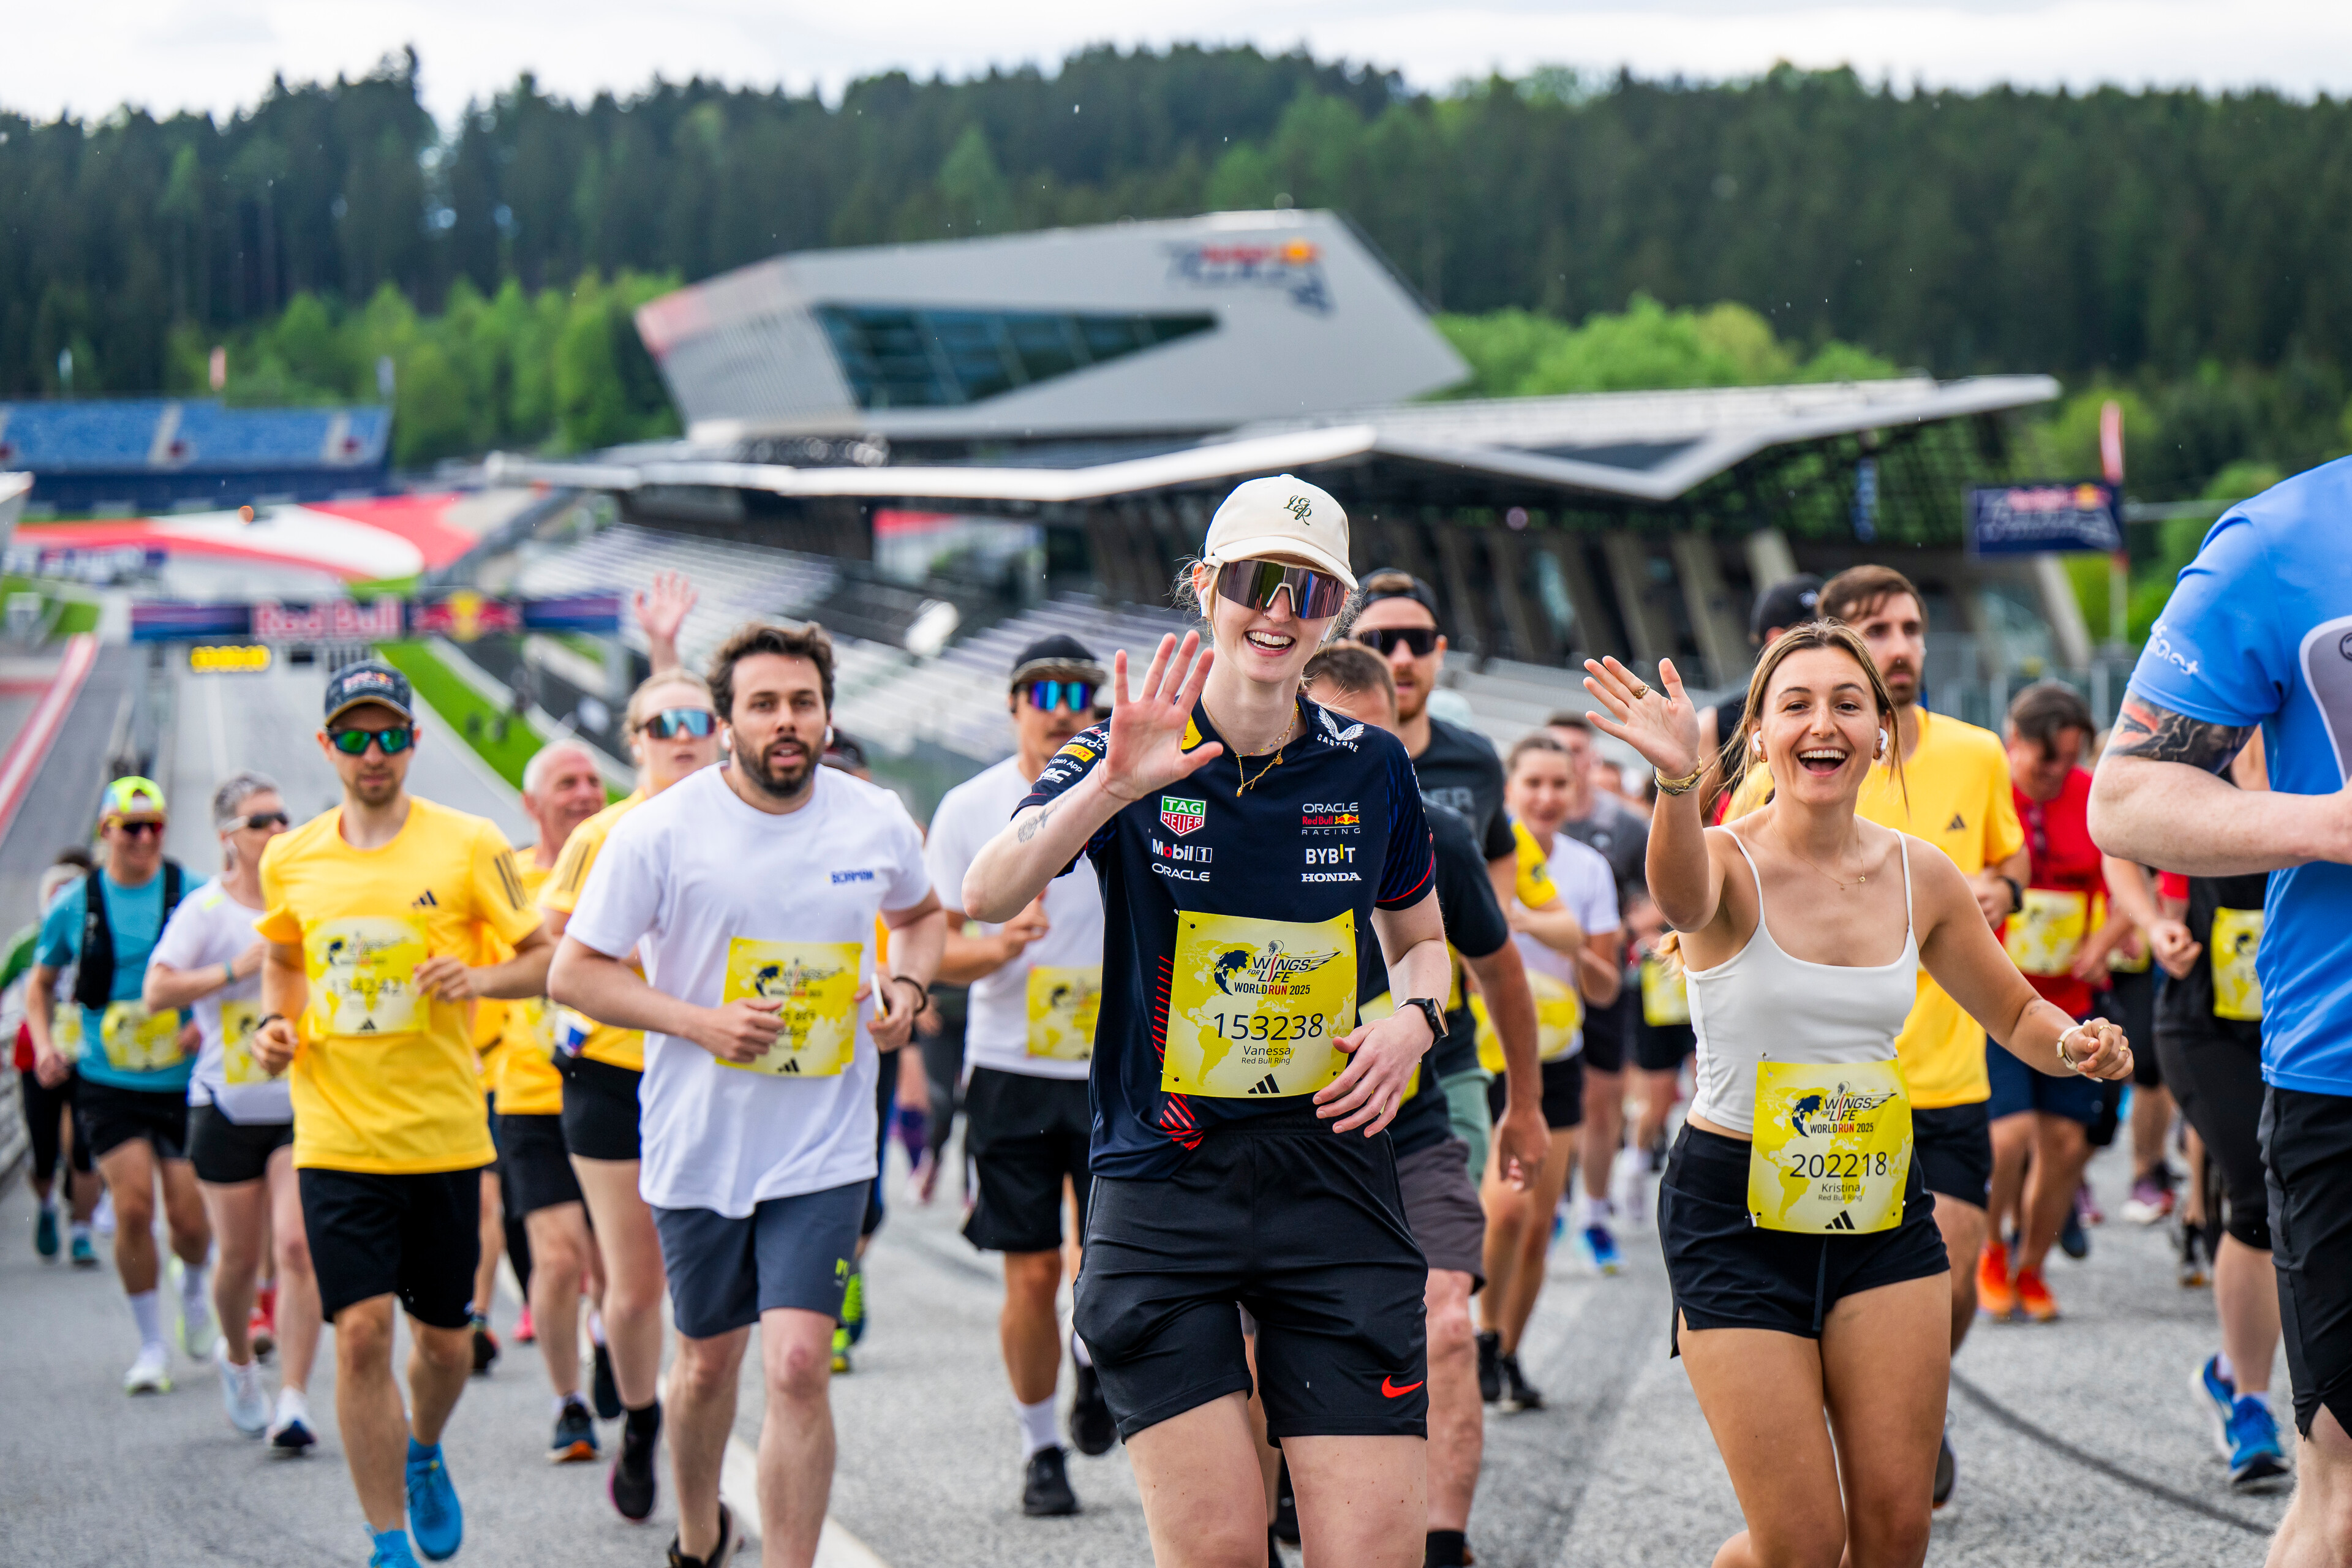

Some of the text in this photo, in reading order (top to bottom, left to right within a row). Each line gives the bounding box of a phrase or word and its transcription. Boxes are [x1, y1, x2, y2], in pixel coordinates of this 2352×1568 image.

[1317, 733, 1359, 753] CASTORE
[1066, 760, 1083, 772] App
[1166, 799, 1201, 814] TAG
[1302, 802, 1359, 813] ORACLE
[1163, 813, 1202, 833] HEUER
[1302, 815, 1333, 825] Red Bull
[1152, 838, 1194, 861] Mobil
[1305, 843, 1356, 864] BYBIT
[1152, 862, 1210, 882] ORACLE
[1301, 872, 1362, 882] HONDA
[1253, 954, 1311, 970] WINGS
[1257, 970, 1294, 983] LIFE
[1289, 984, 1311, 995] 2025
[1213, 1012, 1324, 1041] 153238
[1243, 1045, 1291, 1055] Vanessa
[1274, 1057, 1291, 1066] Ring
[1825, 1094, 1872, 1109] WINGS
[1829, 1109, 1858, 1121] LIFE
[1856, 1122, 1874, 1133] 2025
[1790, 1151, 1887, 1178] 202218
[1822, 1183, 1860, 1193] Kristina
